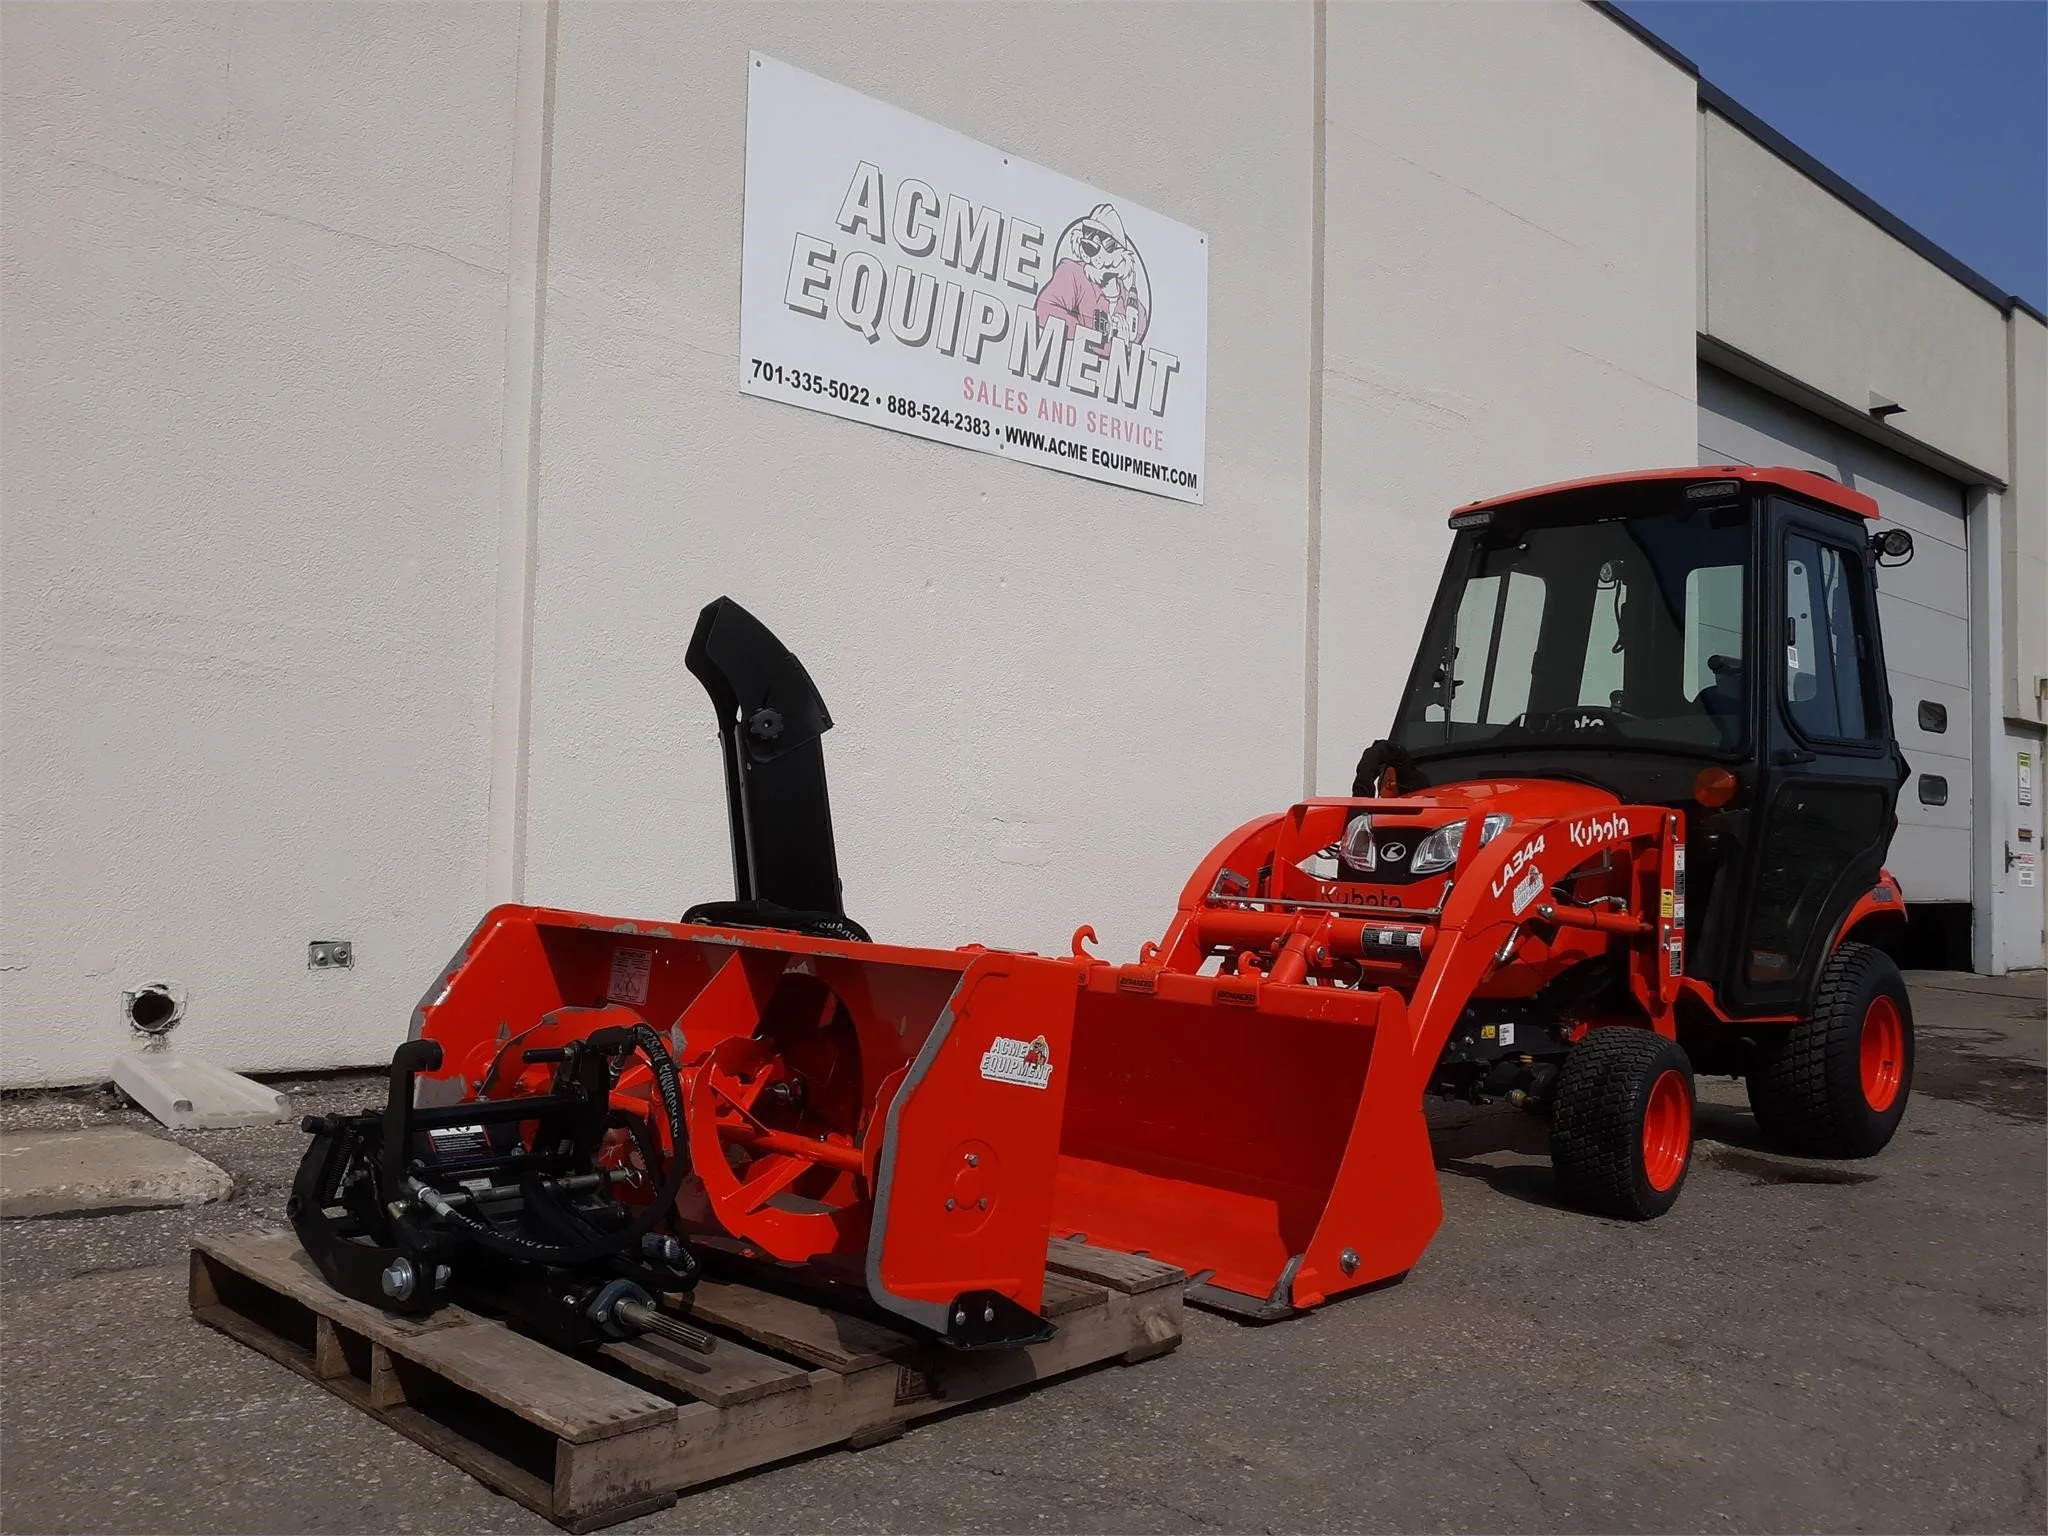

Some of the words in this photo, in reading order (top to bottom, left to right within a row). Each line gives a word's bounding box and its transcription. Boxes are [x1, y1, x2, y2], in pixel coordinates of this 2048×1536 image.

[836, 160, 1044, 295] ACME
[784, 232, 1180, 417] EQUIPMENT
[751, 358, 870, 406] 701-335-5022
[887, 395, 990, 437] 888-524-2383
[1005, 425, 1088, 462] WWW.ACME
[1091, 448, 1197, 490] EQUIPMENT.COM
[963, 376, 1028, 415] SALES
[1037, 398, 1077, 427] AND
[1086, 411, 1164, 451] SERVICE
[1570, 812, 1629, 848] Kubota
[1321, 885, 1403, 908] Kubota
[1491, 834, 1546, 899] LA344
[982, 1053, 1052, 1080] EQUIPMENT
[991, 1038, 1028, 1059] ACME
